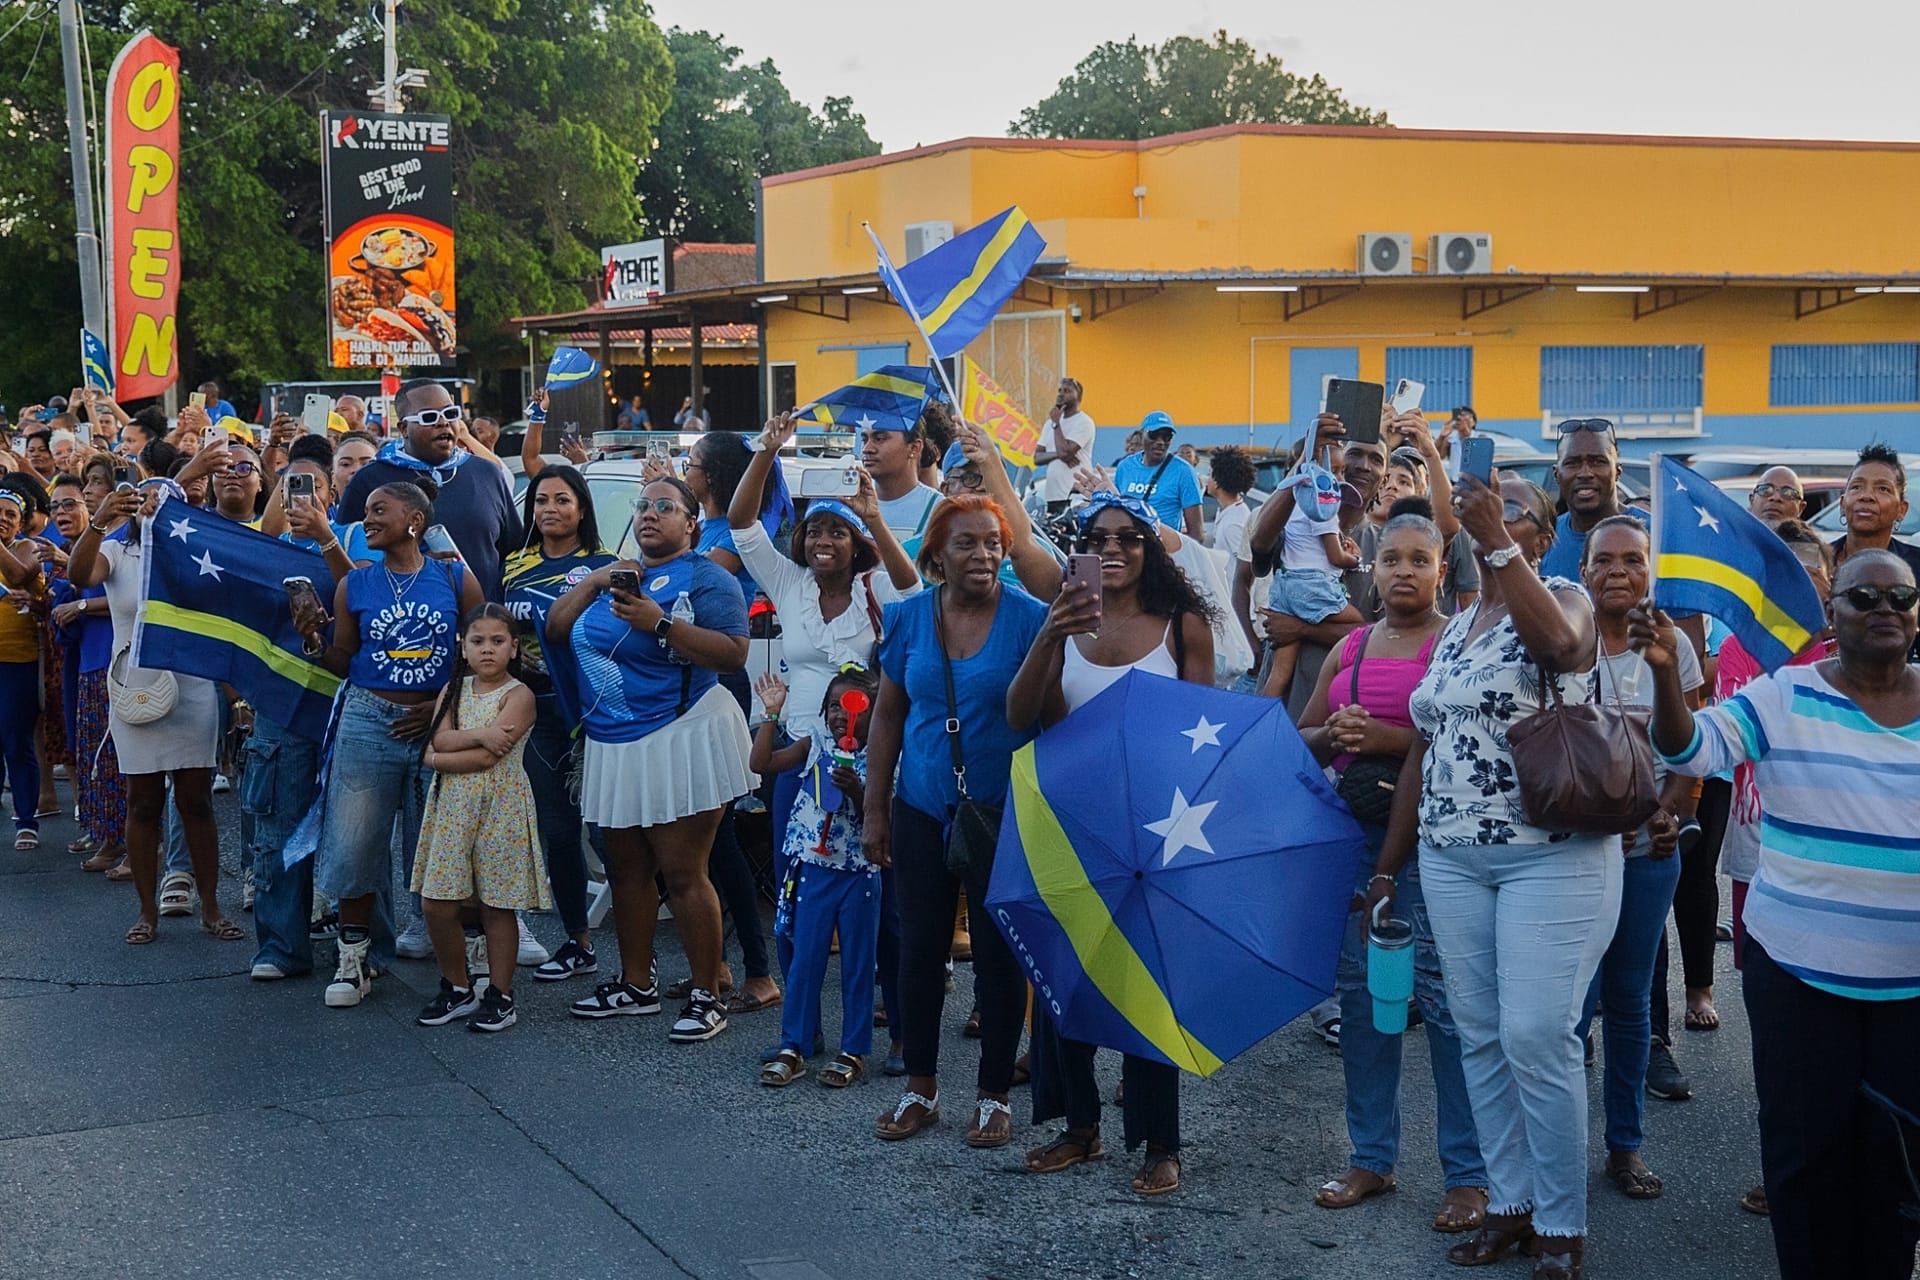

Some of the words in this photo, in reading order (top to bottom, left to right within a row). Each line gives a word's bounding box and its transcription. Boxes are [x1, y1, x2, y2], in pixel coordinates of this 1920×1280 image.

[362, 141, 386, 150] FOOD
[391, 142, 424, 151] CENTER
[358, 167, 389, 188] BEST
[390, 158, 422, 178] FOOD
[363, 185, 382, 201] ON
[384, 176, 406, 195] THE
[387, 185, 426, 211] Island
[122, 62, 176, 378] OPEN
[349, 340, 382, 353] HABRI
[387, 341, 409, 353] TUR
[412, 341, 431, 353] DIA
[350, 353, 372, 366] FOR
[376, 354, 388, 366] DI
[369, 601, 449, 641] ORGUYOSO
[371, 650, 391, 671] DI
[389, 646, 448, 685] KORSOU
